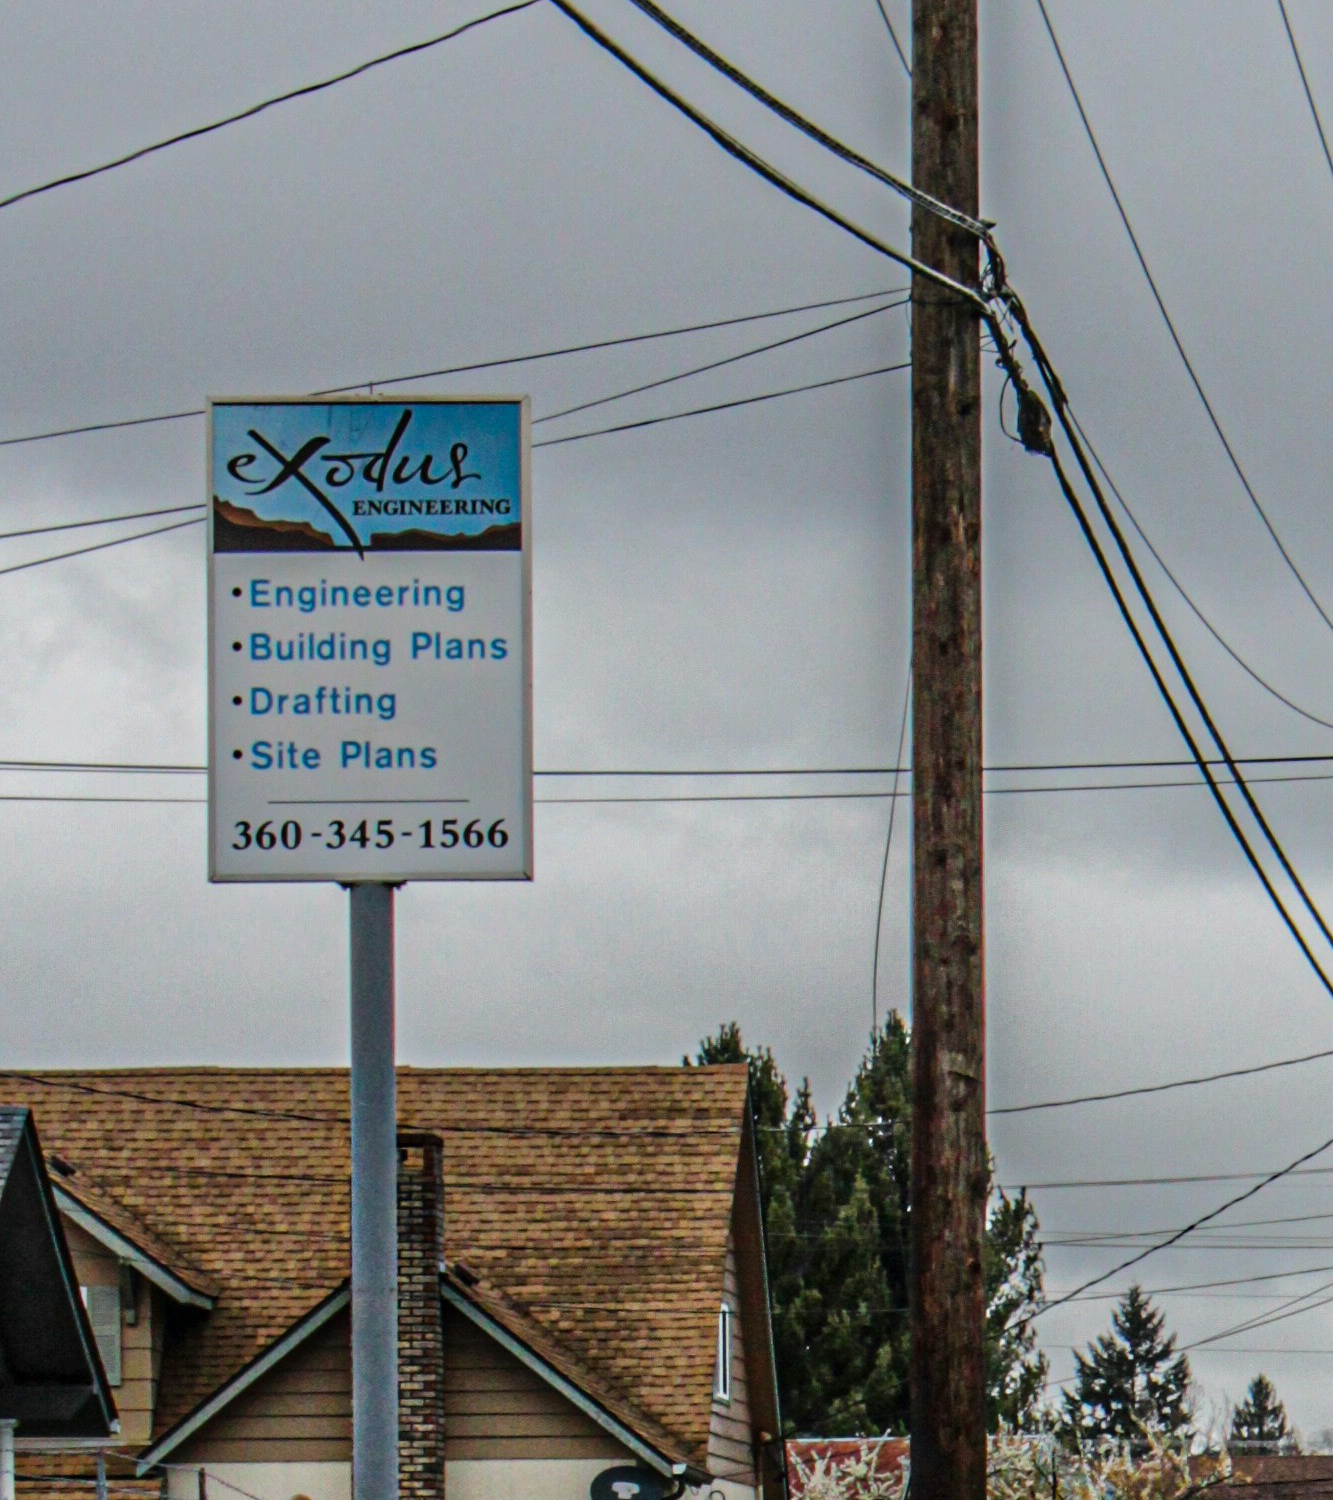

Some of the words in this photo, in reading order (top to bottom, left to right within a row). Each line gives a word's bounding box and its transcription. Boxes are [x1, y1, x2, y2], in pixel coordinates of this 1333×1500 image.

[353, 498, 511, 517] ENGINEERING
[249, 578, 465, 614] Engineering
[249, 632, 391, 667] Building
[411, 631, 508, 661] Plans
[249, 686, 396, 721] Drafting
[250, 740, 320, 770] Site
[340, 740, 437, 770] Plans
[231, 818, 509, 851] 360-345-1566
